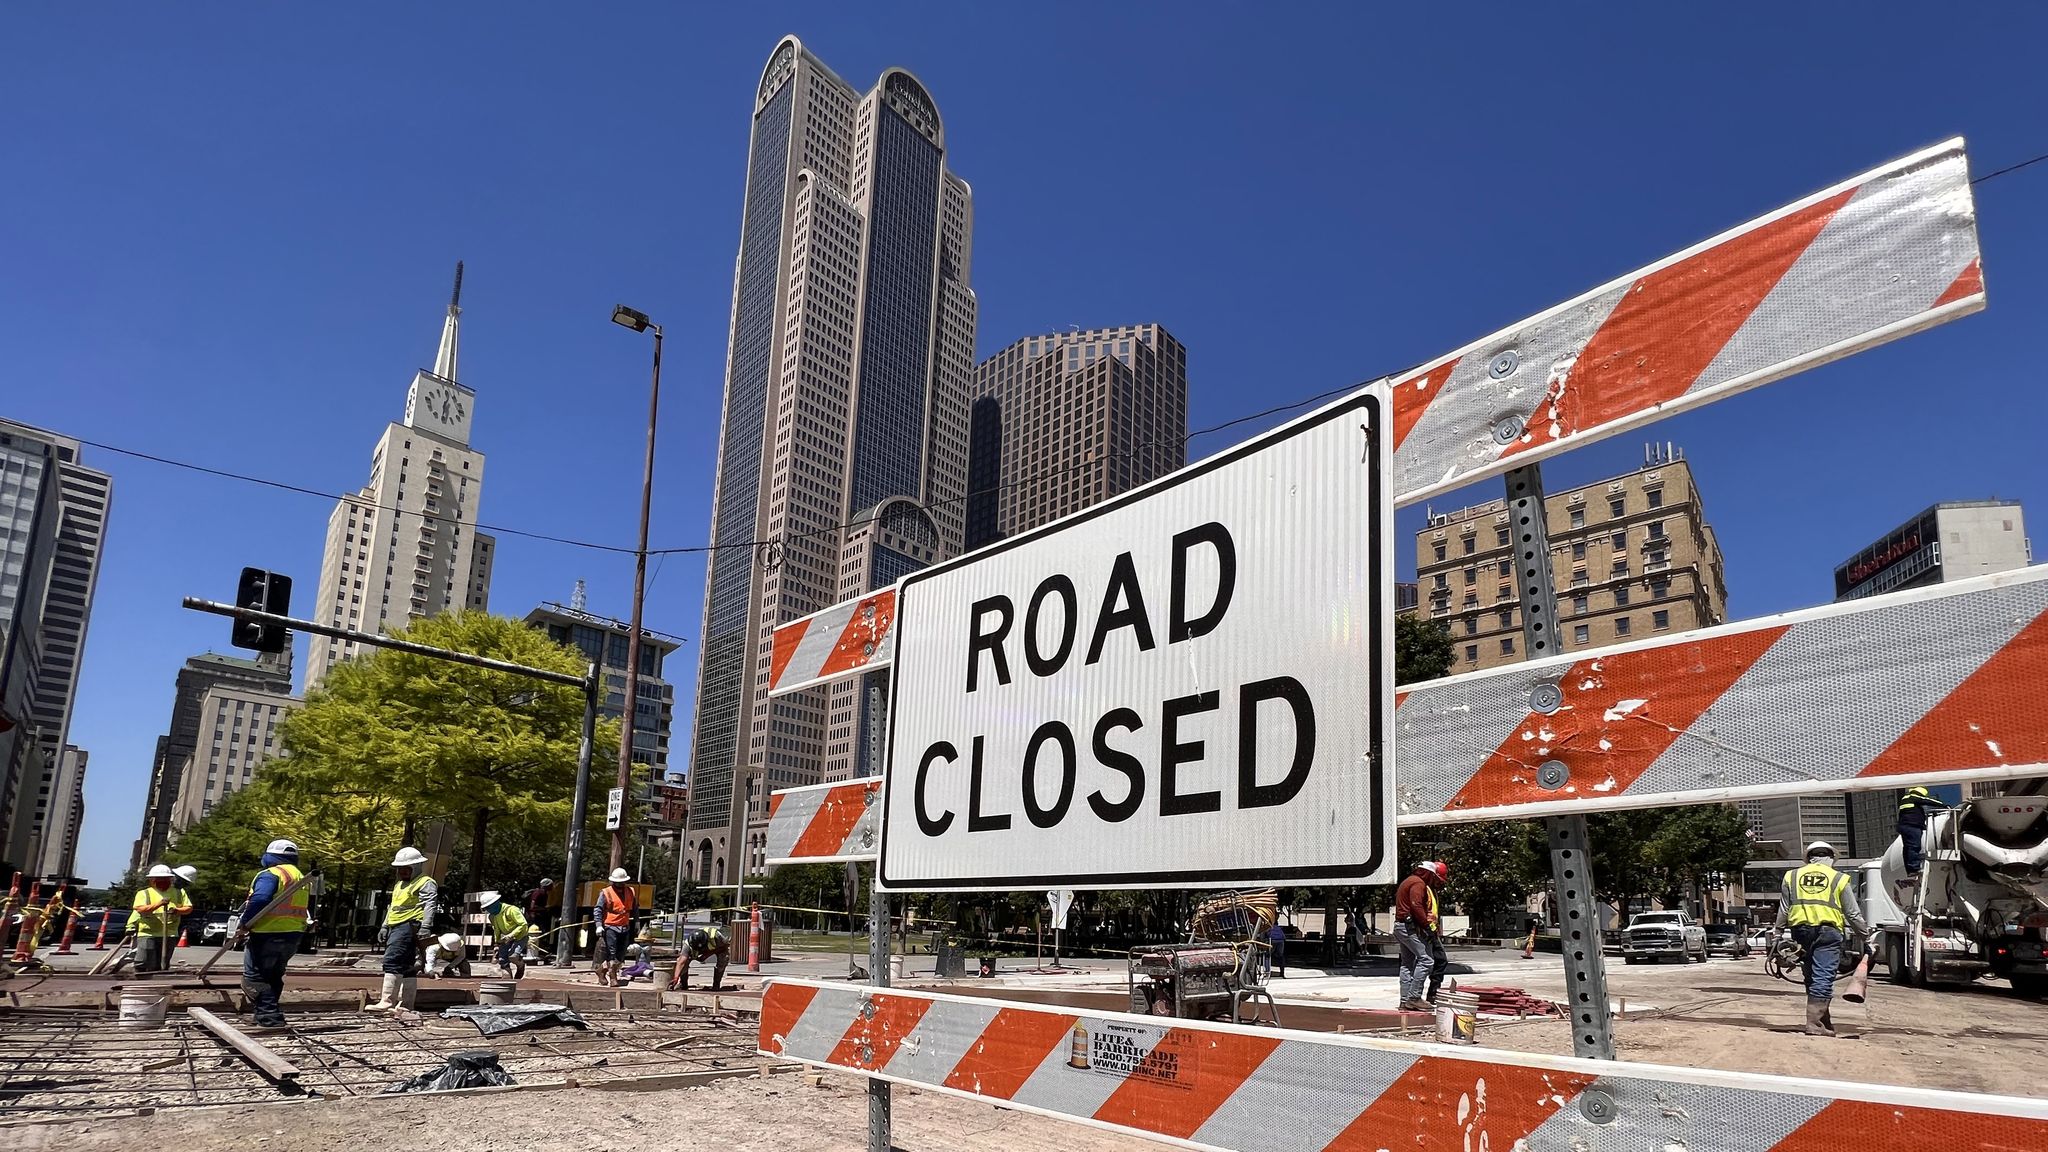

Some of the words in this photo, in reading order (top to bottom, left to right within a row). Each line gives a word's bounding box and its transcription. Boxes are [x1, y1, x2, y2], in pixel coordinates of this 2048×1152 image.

[966, 521, 1237, 693] ROAD
[914, 676, 1316, 837] CLOSED
[610, 791, 621, 802] ONE
[609, 803, 620, 812] WAY
[1803, 875, 1826, 887] HZ
[1107, 1024, 1137, 1034] PROPERTY
[1093, 1041, 1179, 1062] BARRICADE
[1093, 1051, 1179, 1072] 1.800.755.5791
[1093, 1058, 1178, 1080] WWW.DLBINC.NET
